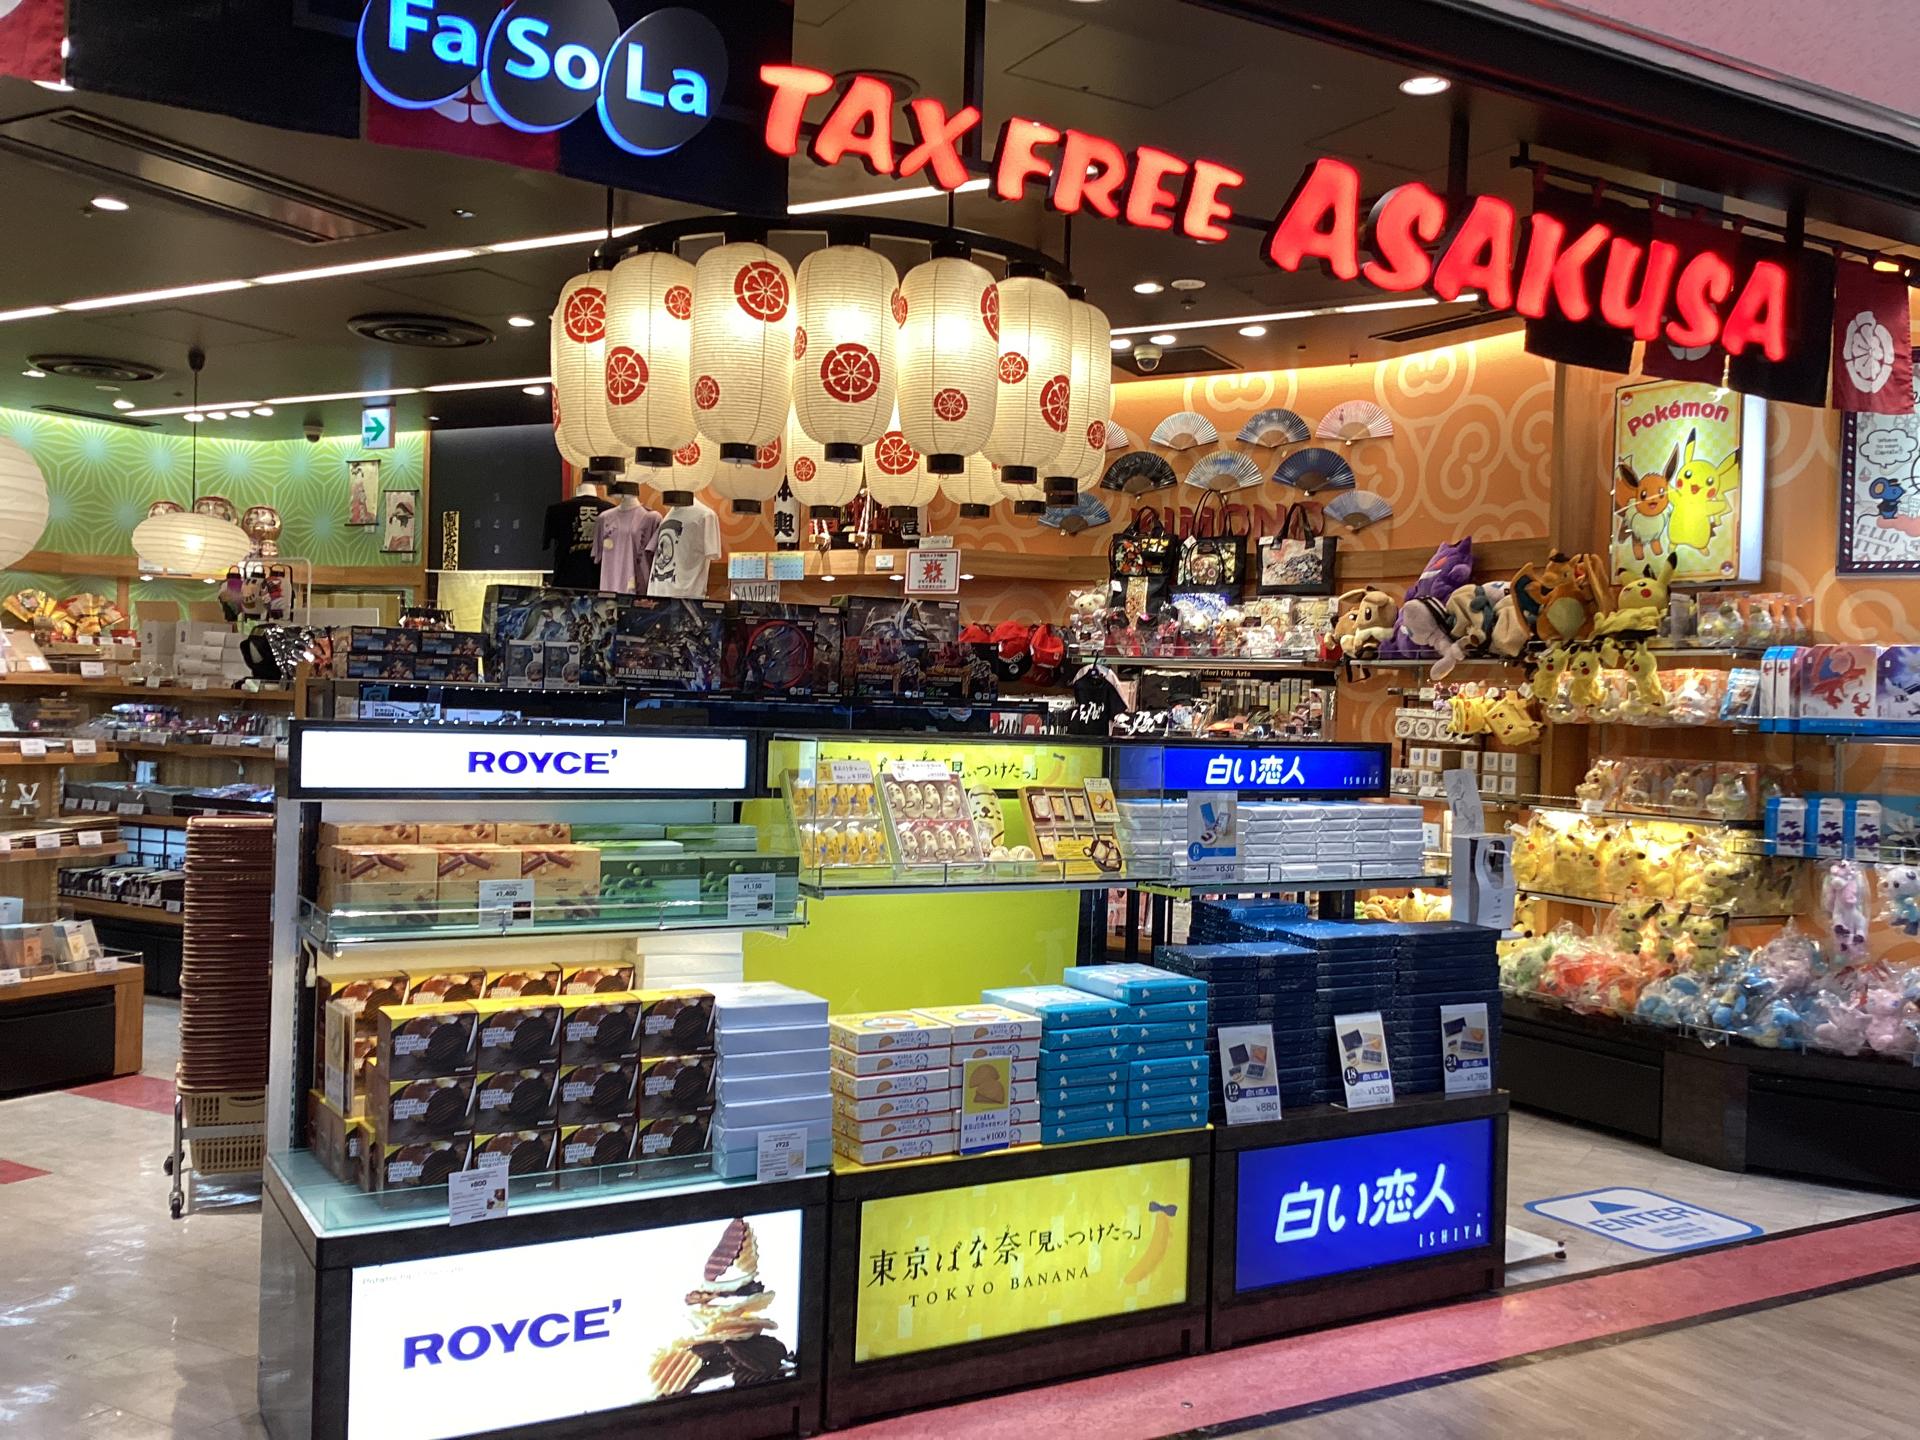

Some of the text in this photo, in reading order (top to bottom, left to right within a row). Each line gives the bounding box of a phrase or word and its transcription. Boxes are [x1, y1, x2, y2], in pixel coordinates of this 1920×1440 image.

[760, 64, 1787, 362] TAX FREE ASAKUSA
[1627, 400, 1730, 436] Pokémon
[1857, 523, 1900, 545] ELLO
[733, 584, 777, 602] SAMPLE
[1204, 753, 1306, 785] 白い恋人
[1346, 1068, 1357, 1080] 18
[1227, 1083, 1239, 1096] 12
[1256, 1102, 1278, 1112] ¥880
[1274, 1162, 1456, 1244] 白い恋人
[1588, 1205, 1700, 1232] ENTER
[908, 1266, 1090, 1308] TOKYO BANANA
[403, 1298, 622, 1370] ROYCE'
